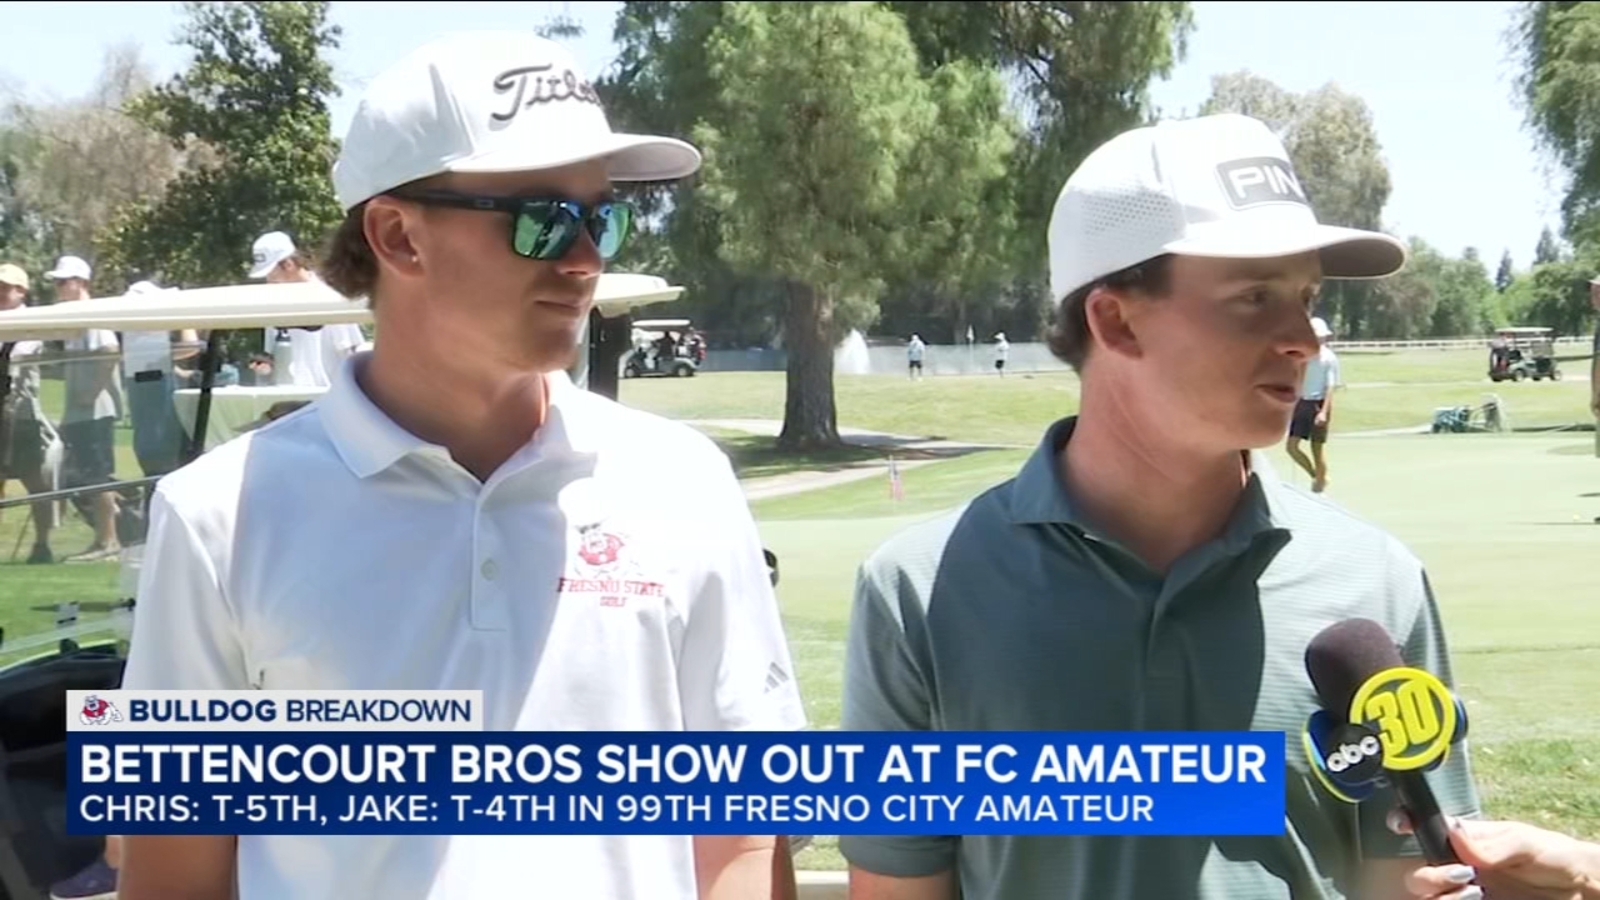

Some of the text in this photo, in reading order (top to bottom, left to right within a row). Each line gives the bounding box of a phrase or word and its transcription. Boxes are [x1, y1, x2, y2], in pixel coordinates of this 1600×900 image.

[1229, 164, 1305, 199] PIN
[557, 577, 664, 598] FRESNO STATE
[1365, 679, 1440, 757] 30
[1327, 735, 1380, 772] abc
